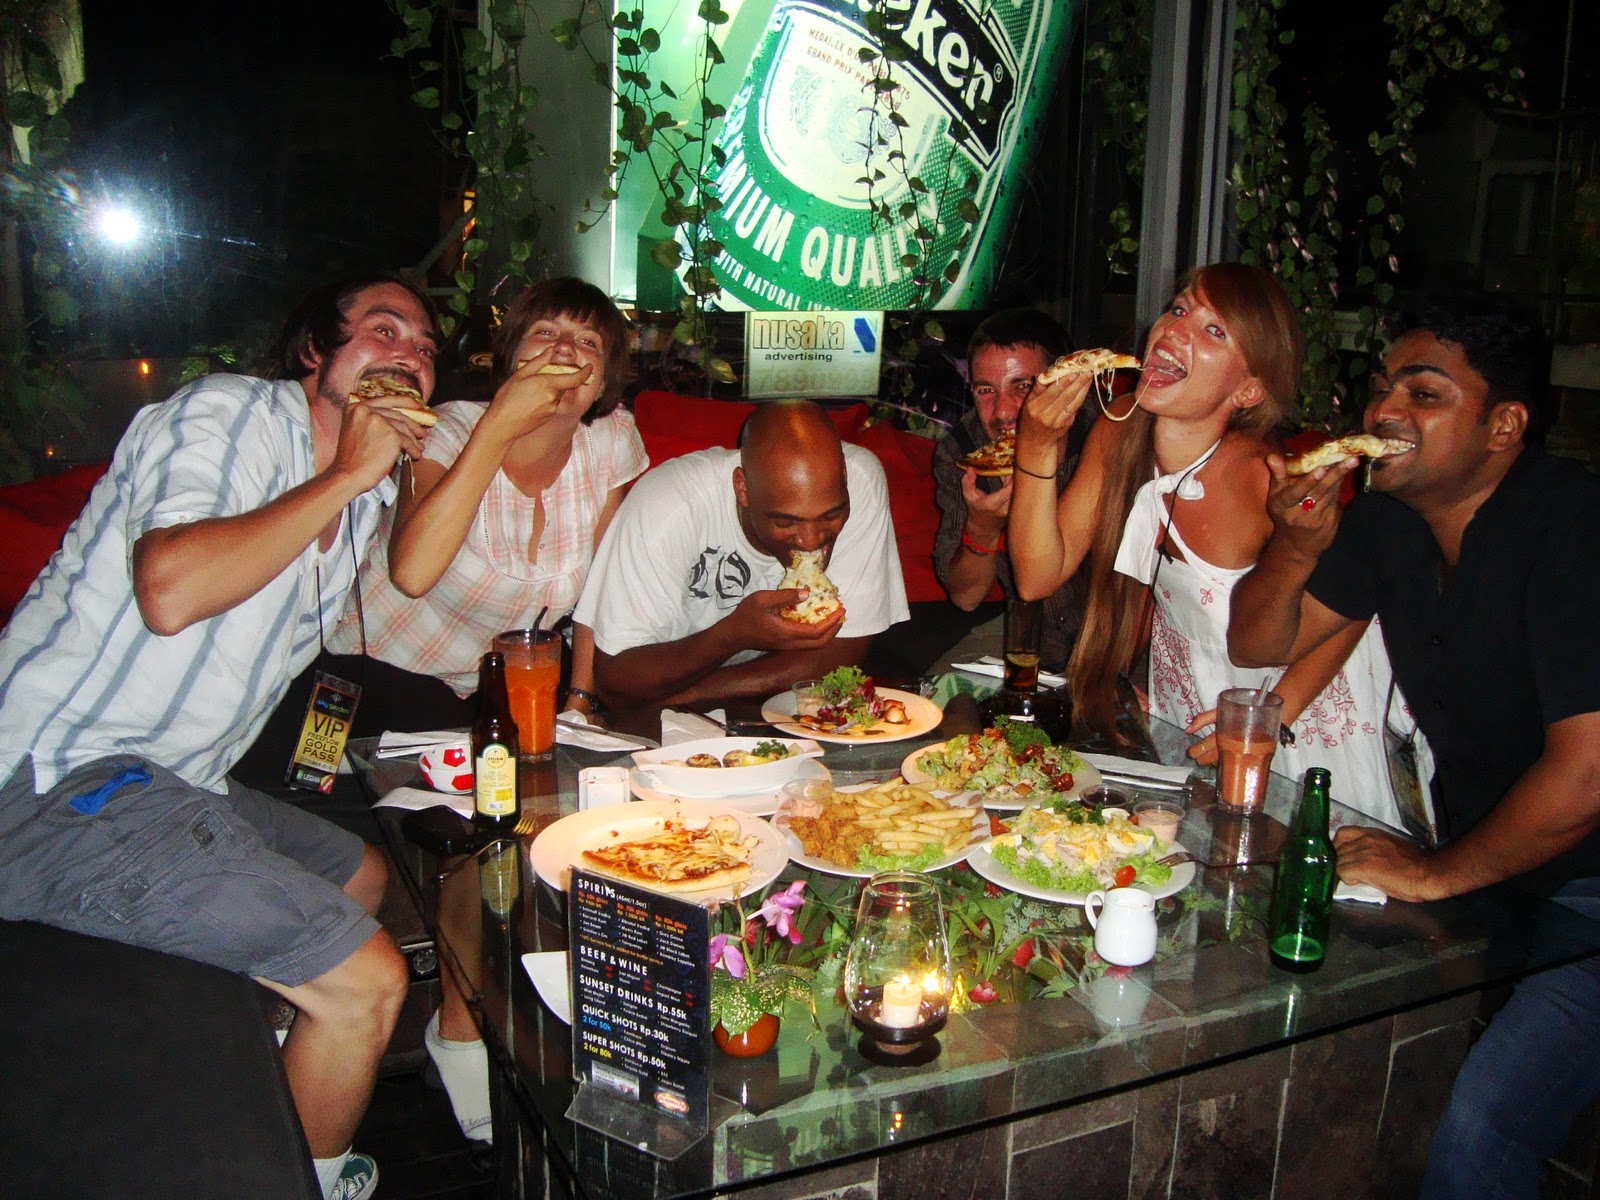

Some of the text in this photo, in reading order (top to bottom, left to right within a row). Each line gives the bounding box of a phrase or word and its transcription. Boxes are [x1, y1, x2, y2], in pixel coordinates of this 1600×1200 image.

[807, 46, 832, 64] GRAND
[834, 58, 854, 74] PRIX
[742, 271, 801, 311] NATURAL
[752, 315, 845, 350] nusaka
[764, 352, 833, 363] advertising
[313, 713, 345, 738] VIP
[302, 746, 335, 763] PASS
[305, 738, 338, 755] GOLD
[578, 879, 615, 898] SPIRITS
[580, 945, 648, 976] BEER & WINE
[580, 974, 687, 1020] SUNSET DRINKS Rp.55k
[582, 1003, 669, 1042] QUICK SHOTS Rp.30k
[583, 1015, 612, 1031] 2 for 50k
[583, 1031, 666, 1070] SUPER SHOTS Rp.50k
[583, 1042, 612, 1059] 2 for 80k
